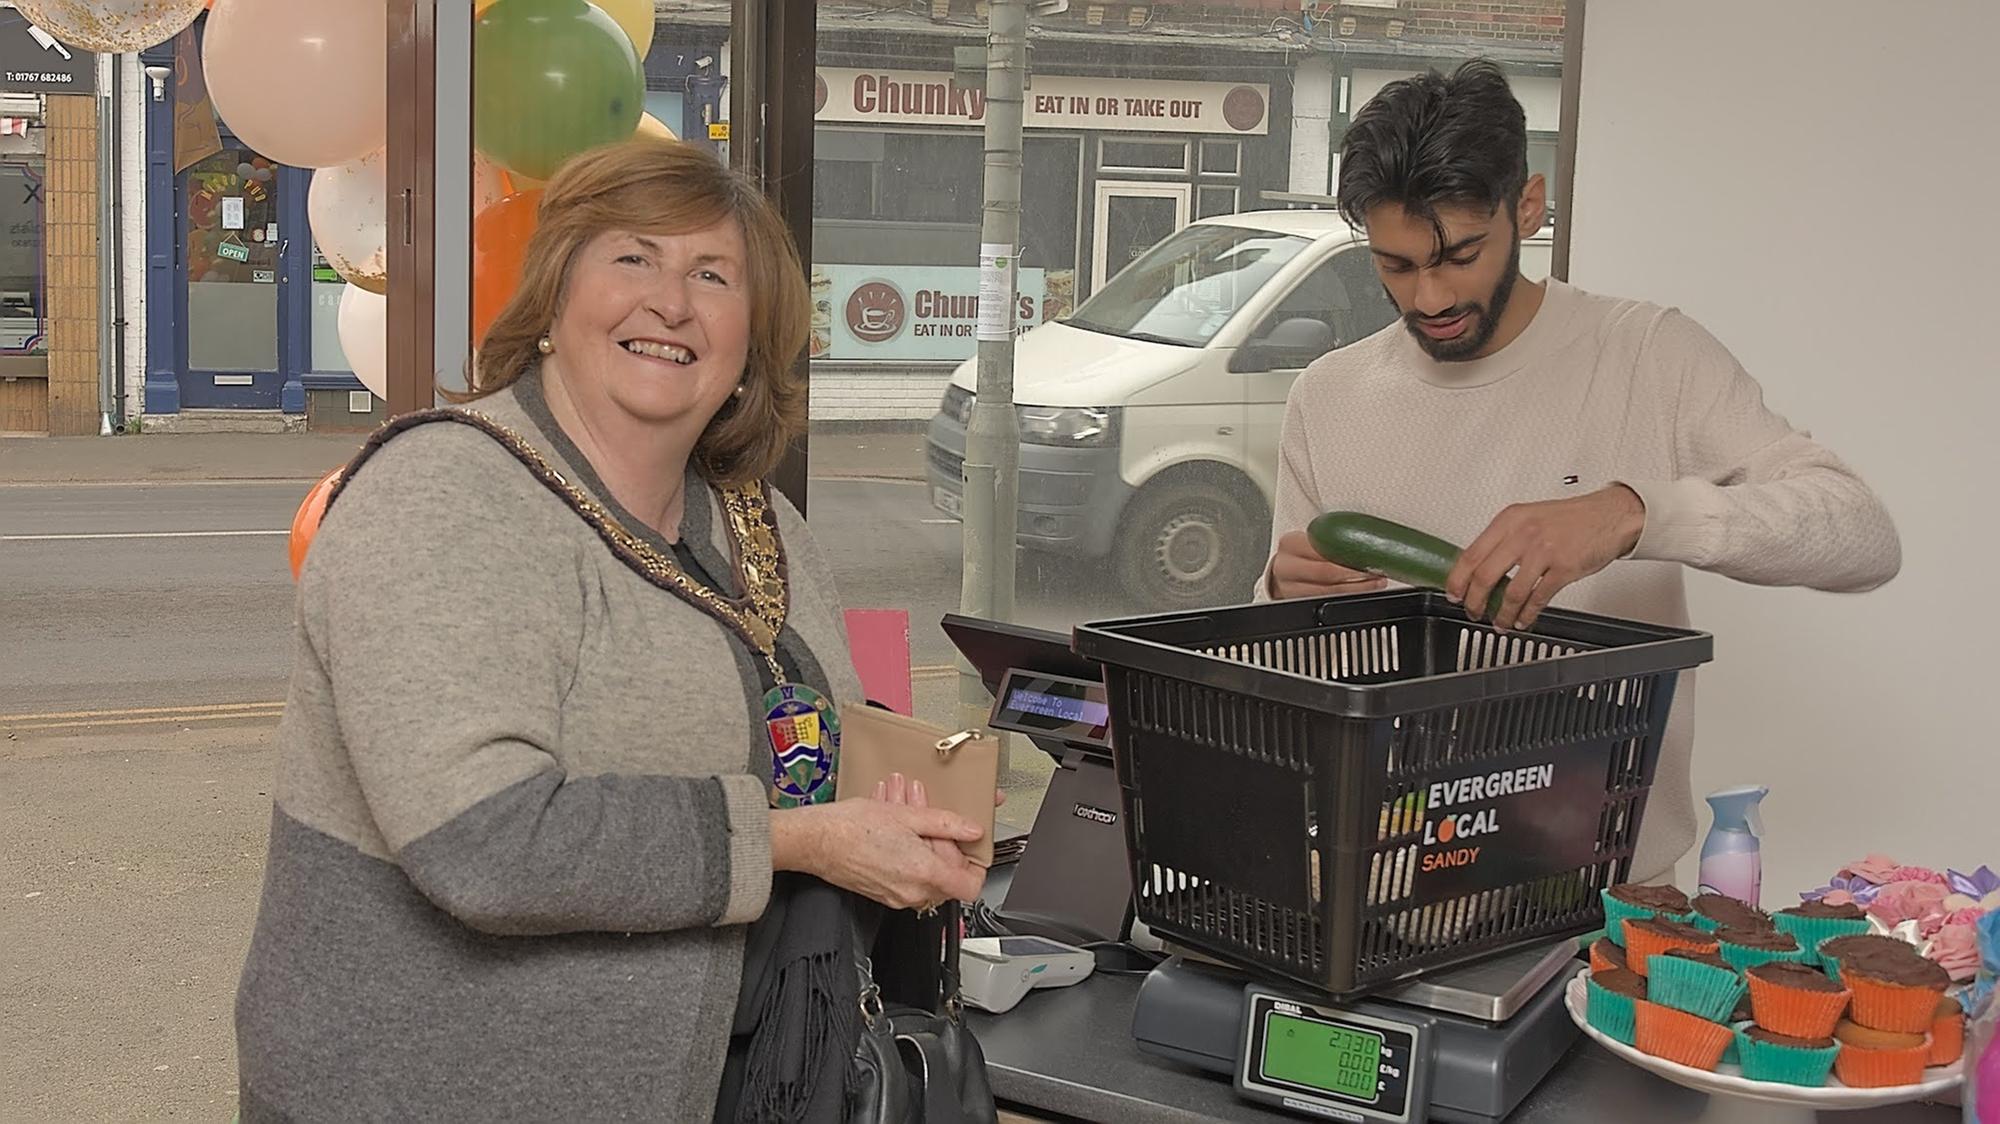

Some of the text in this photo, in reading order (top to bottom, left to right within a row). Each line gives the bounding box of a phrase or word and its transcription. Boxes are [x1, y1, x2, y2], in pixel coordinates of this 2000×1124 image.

[677, 55, 684, 66] 7
[6, 72, 72, 83] T: 01767 682486
[1035, 95, 1064, 114] EAT
[1069, 96, 1089, 116] IN
[1095, 97, 1119, 116] OR
[1124, 98, 1165, 118] TAKE
[1169, 100, 1203, 119] OUT
[222, 247, 245, 259] OPEN
[914, 289, 1035, 320] Chun's
[914, 324, 972, 337] EAT IN OR
[1012, 690, 1063, 708] Welcome To
[1057, 708, 1084, 721] Local
[1427, 763, 1554, 810] EVERGREEN
[1423, 808, 1500, 846] LOCAL
[1421, 846, 1480, 872] SANDY
